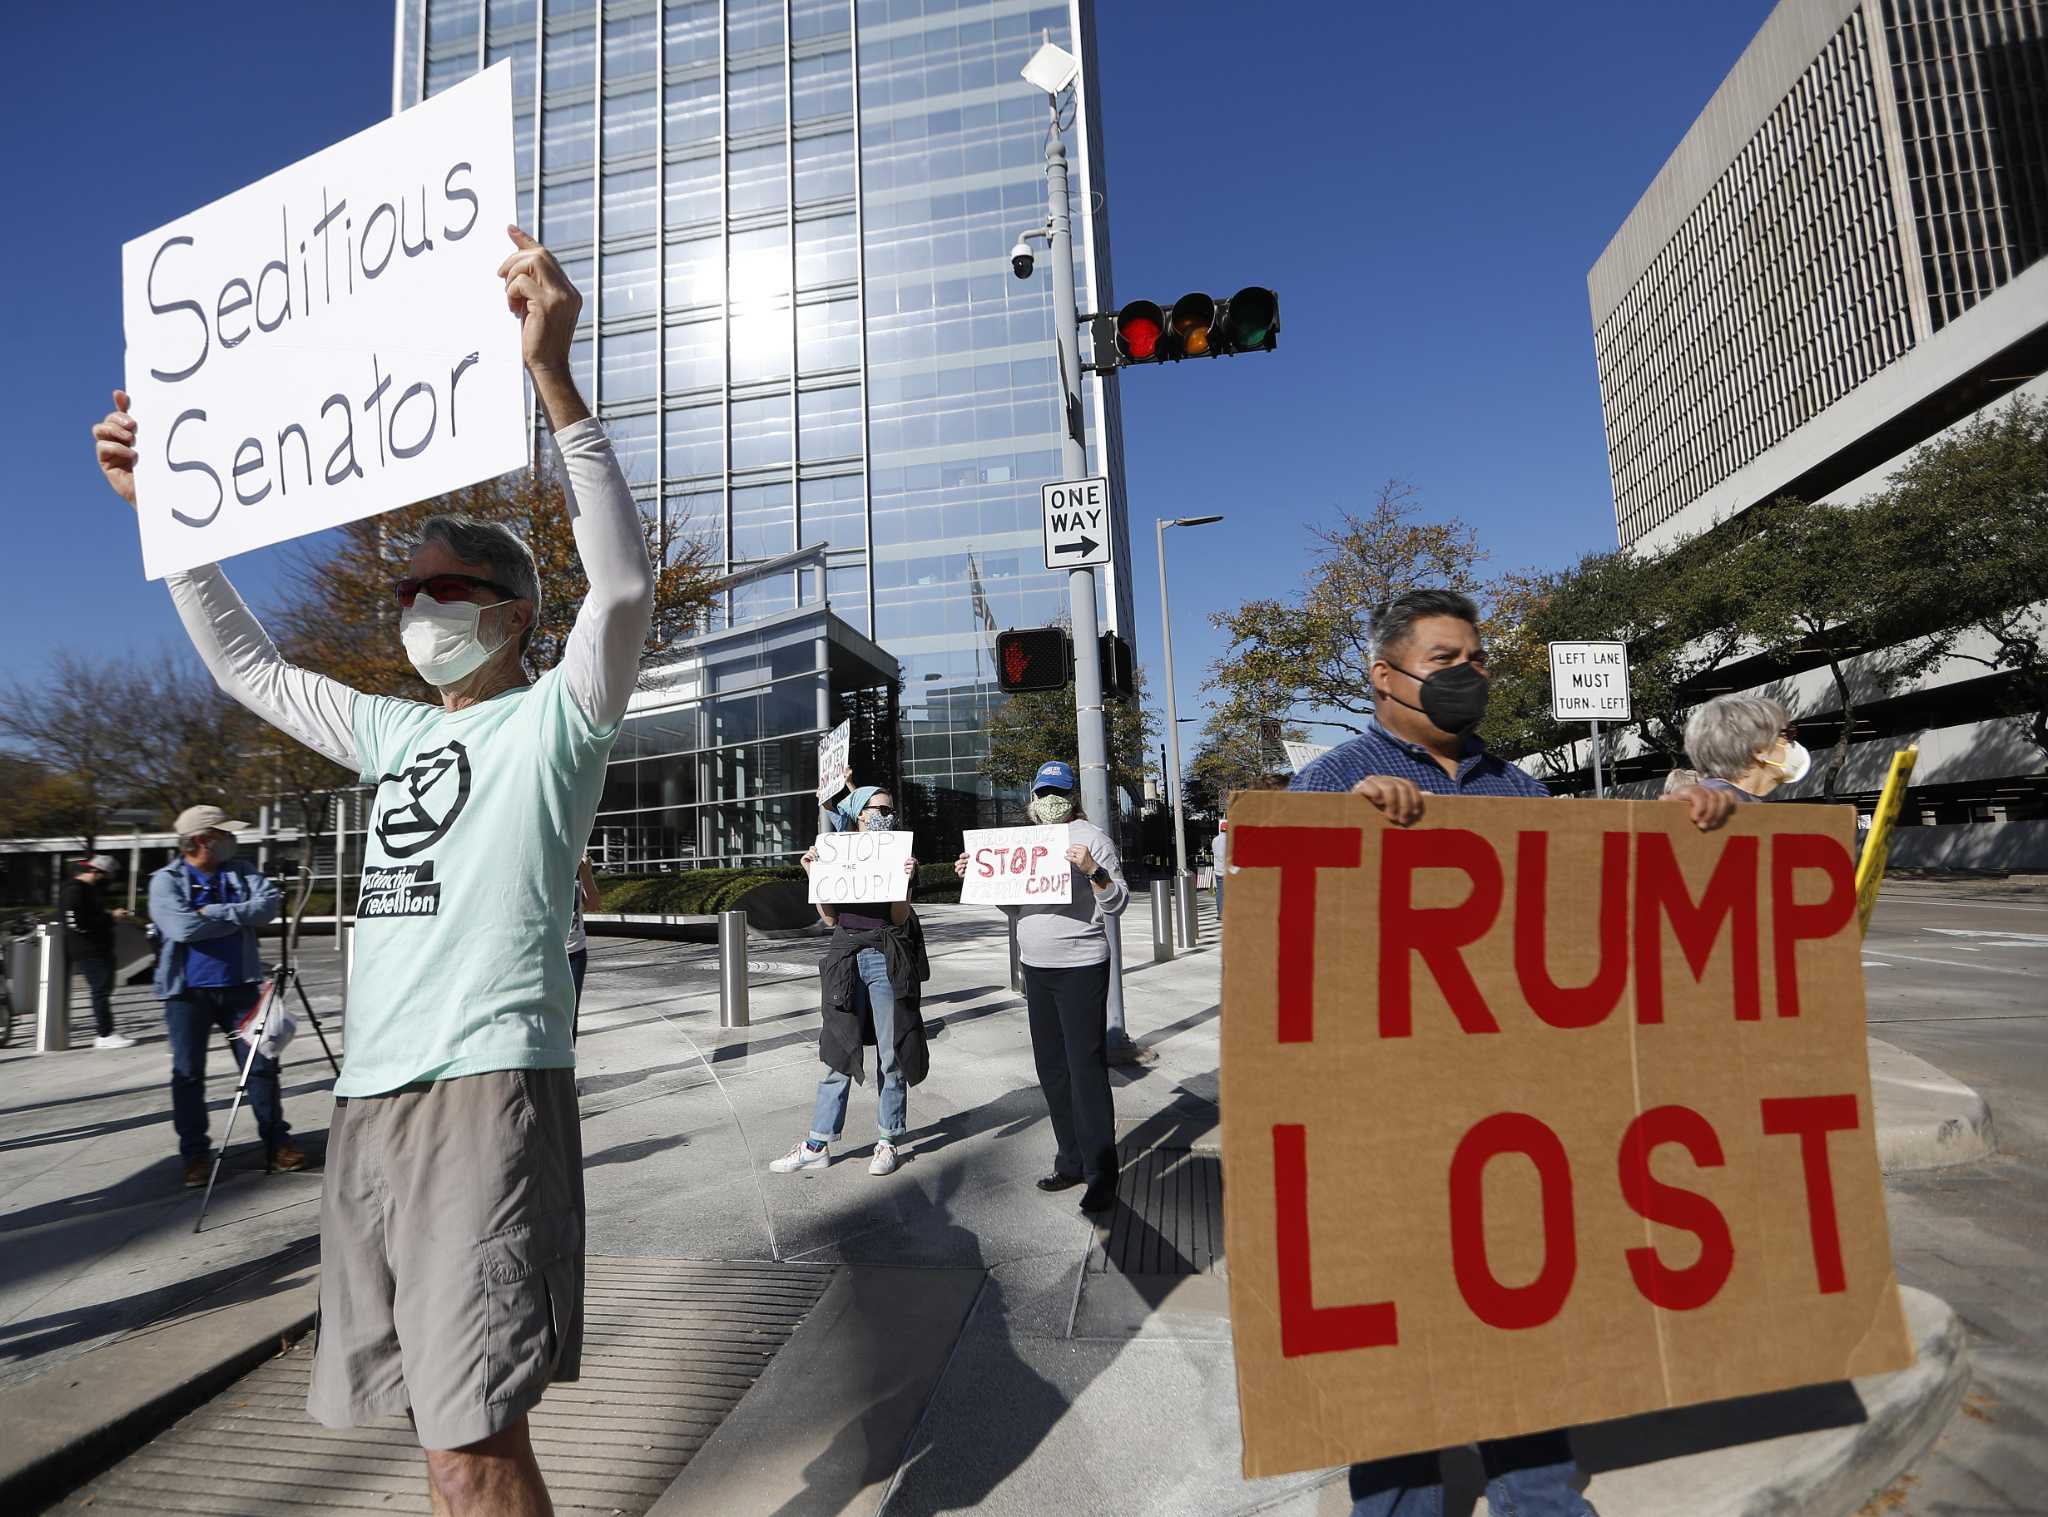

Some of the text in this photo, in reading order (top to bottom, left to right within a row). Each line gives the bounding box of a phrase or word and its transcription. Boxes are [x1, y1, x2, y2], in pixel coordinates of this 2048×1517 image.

[148, 162, 479, 383] Seditious
[166, 351, 480, 528] Senator
[1051, 486, 1100, 509] ONE
[1051, 509, 1102, 533] WAY
[1559, 652, 1620, 664] LEFT LANE
[1572, 673, 1609, 688] MUST
[1559, 697, 1625, 710] TURN LEFT
[819, 832, 895, 864] STOP
[975, 846, 1049, 878] STOP
[841, 863, 857, 872] THE
[816, 872, 893, 902] COUP!
[365, 889, 435, 915] rebellion
[1231, 824, 1859, 1044] TRUMP
[1272, 1093, 1860, 1359] LOST
